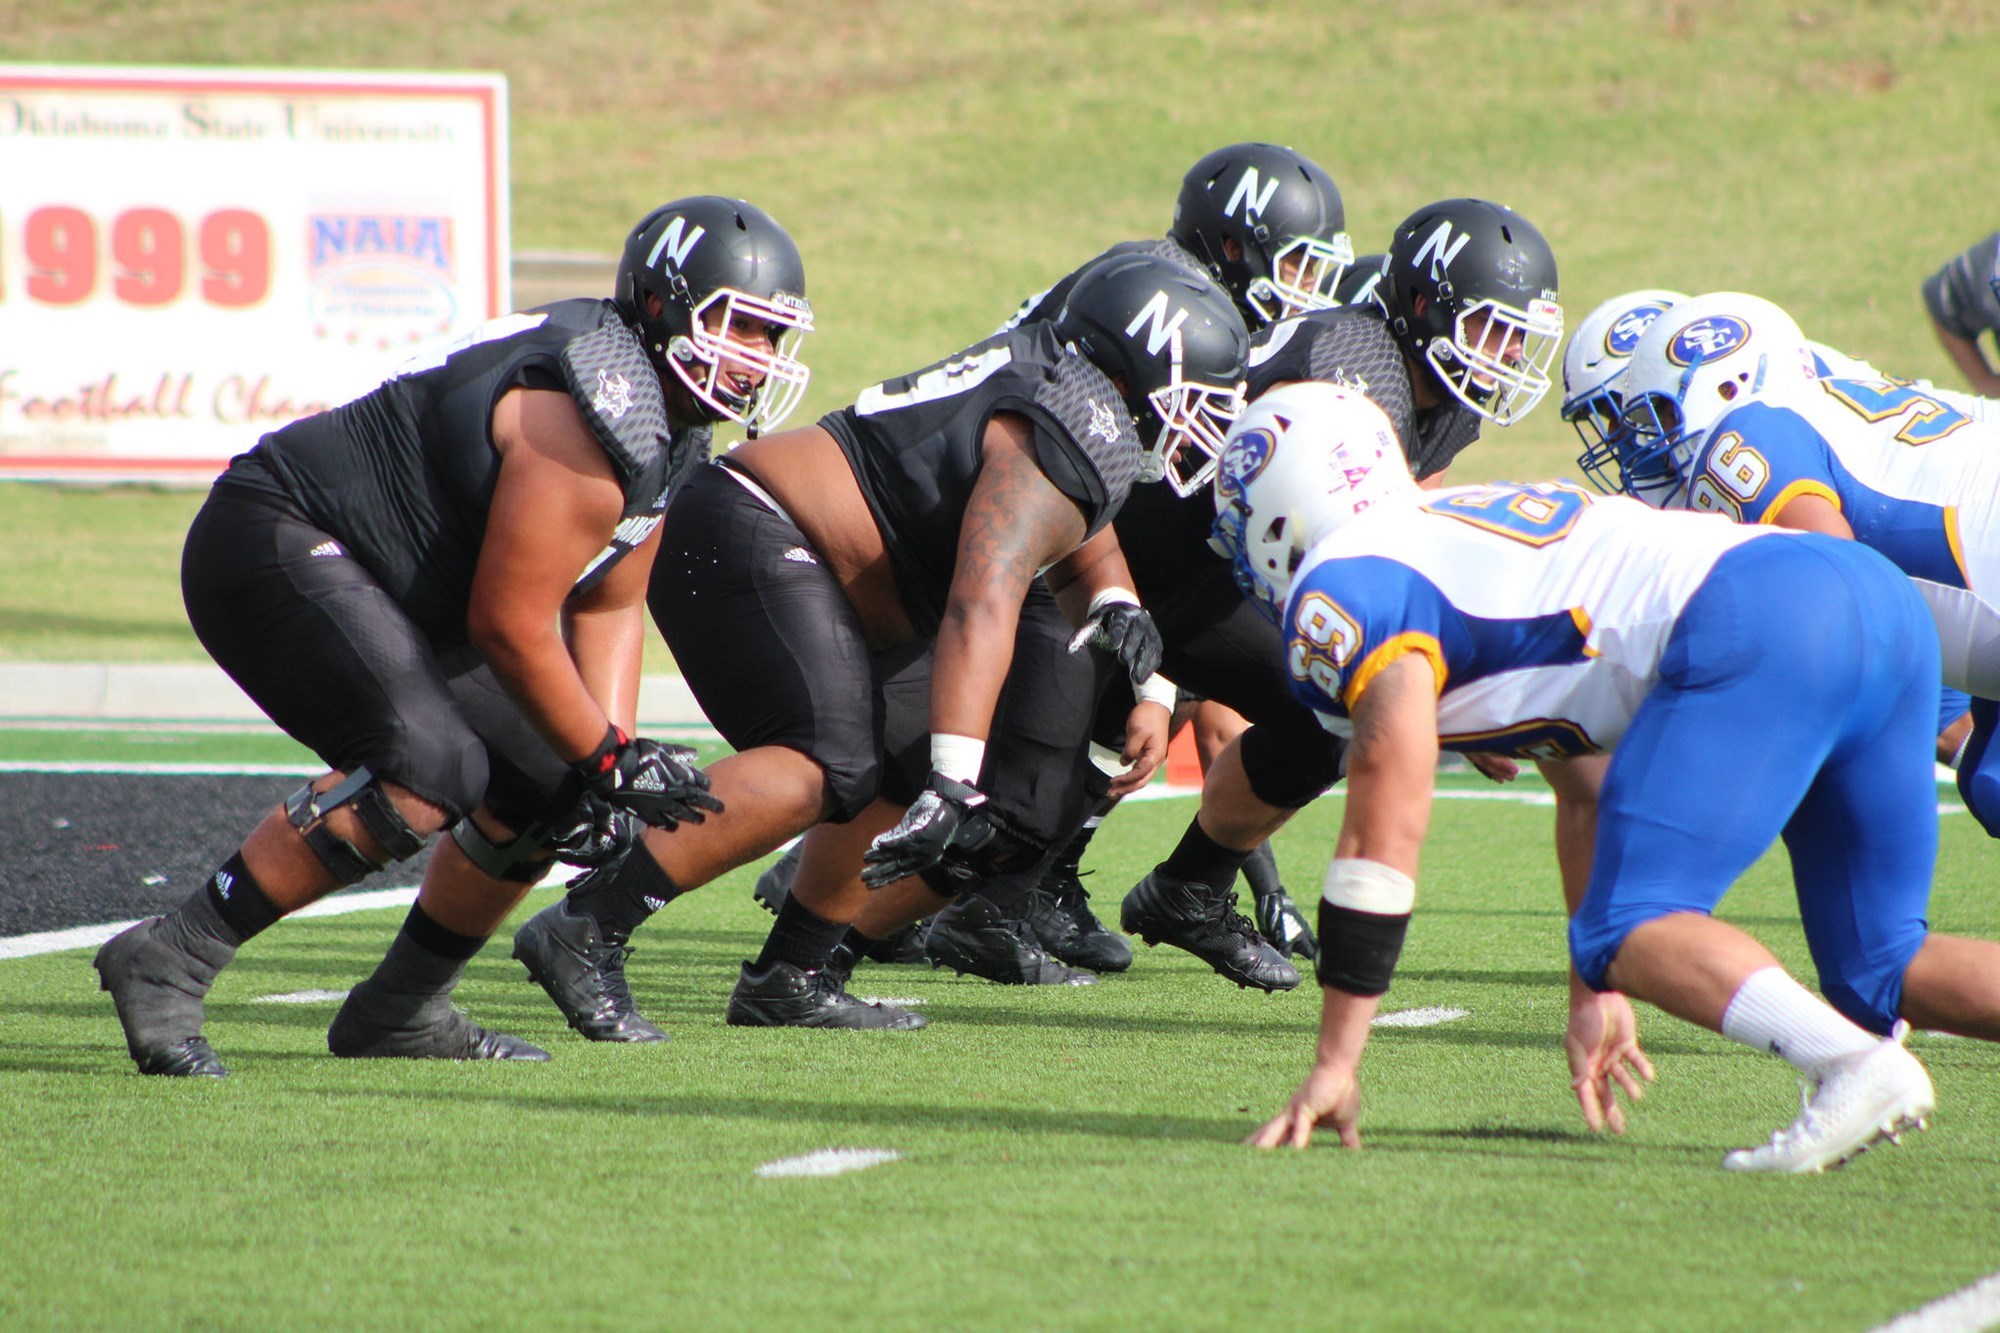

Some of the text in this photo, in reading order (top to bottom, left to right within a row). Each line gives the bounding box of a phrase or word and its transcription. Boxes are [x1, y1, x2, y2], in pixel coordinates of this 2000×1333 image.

[181, 100, 267, 139] State
[1224, 166, 1280, 228] N
[313, 217, 447, 267] NAIA
[646, 216, 707, 279] N
[1412, 220, 1471, 283] N
[1125, 290, 1190, 357] N
